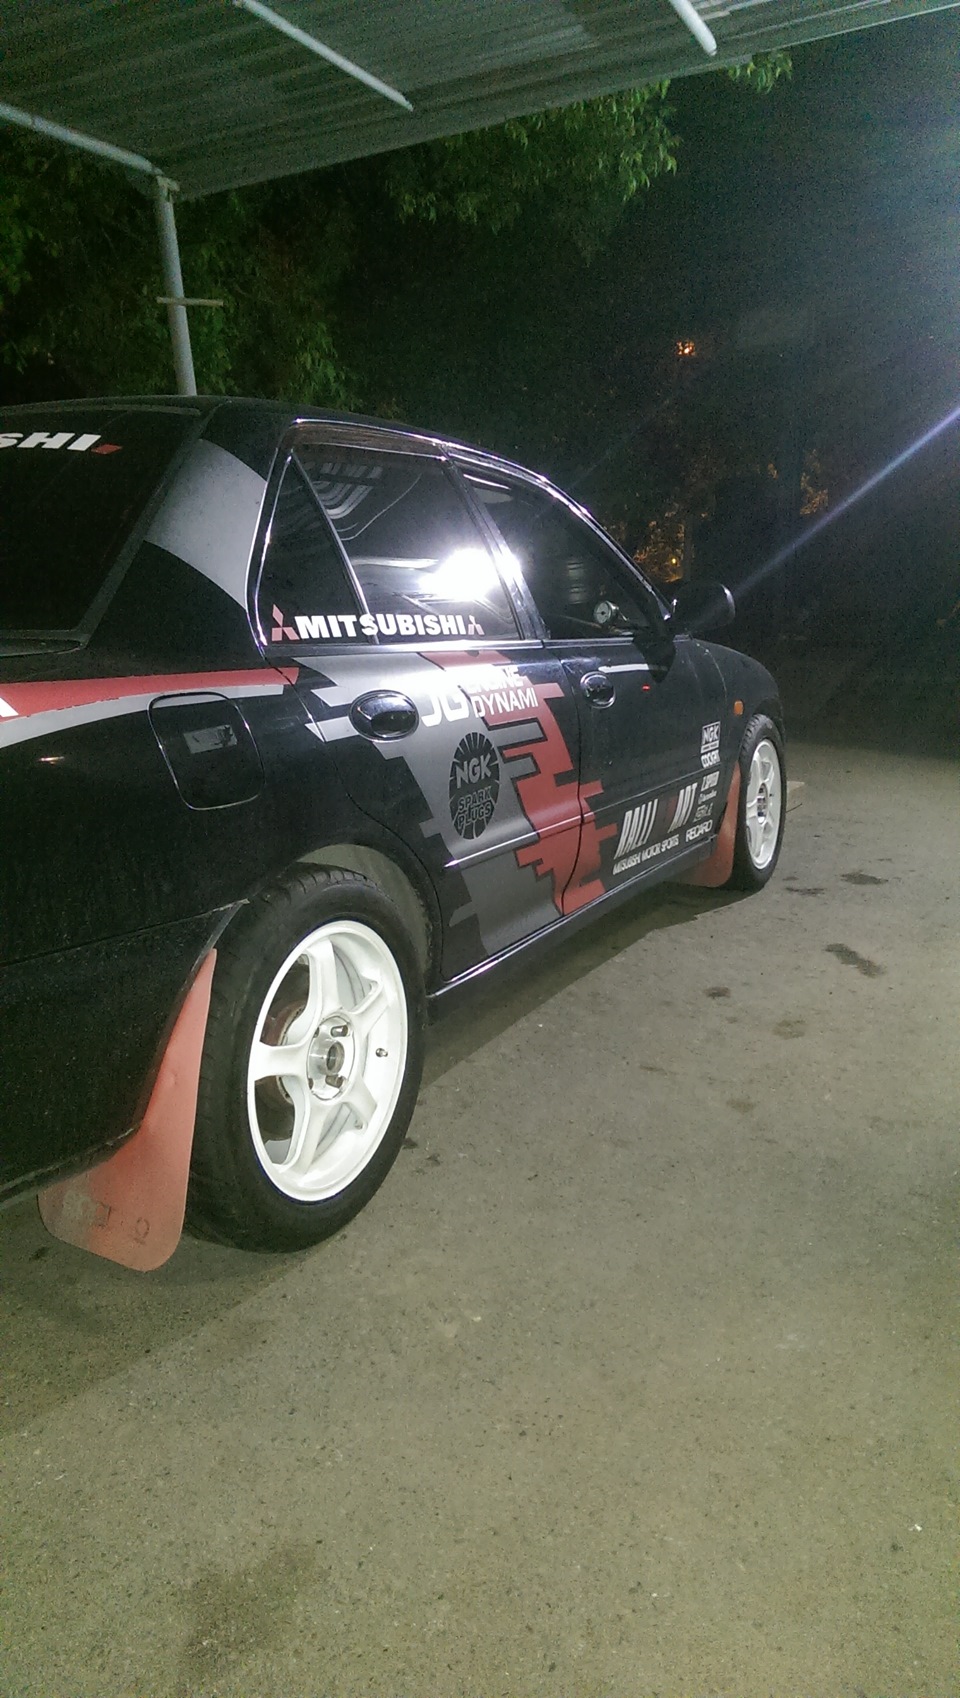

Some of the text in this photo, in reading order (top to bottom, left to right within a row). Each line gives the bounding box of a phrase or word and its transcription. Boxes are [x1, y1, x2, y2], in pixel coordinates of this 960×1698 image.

[294, 614, 467, 640] MITSUBISHI
[470, 687, 539, 718] DYNAMI
[702, 723, 720, 745] NGK
[456, 752, 492, 789] NGK
[457, 785, 492, 813] SPARK
[457, 801, 495, 829] PLUGS
[685, 819, 714, 843] RECARO
